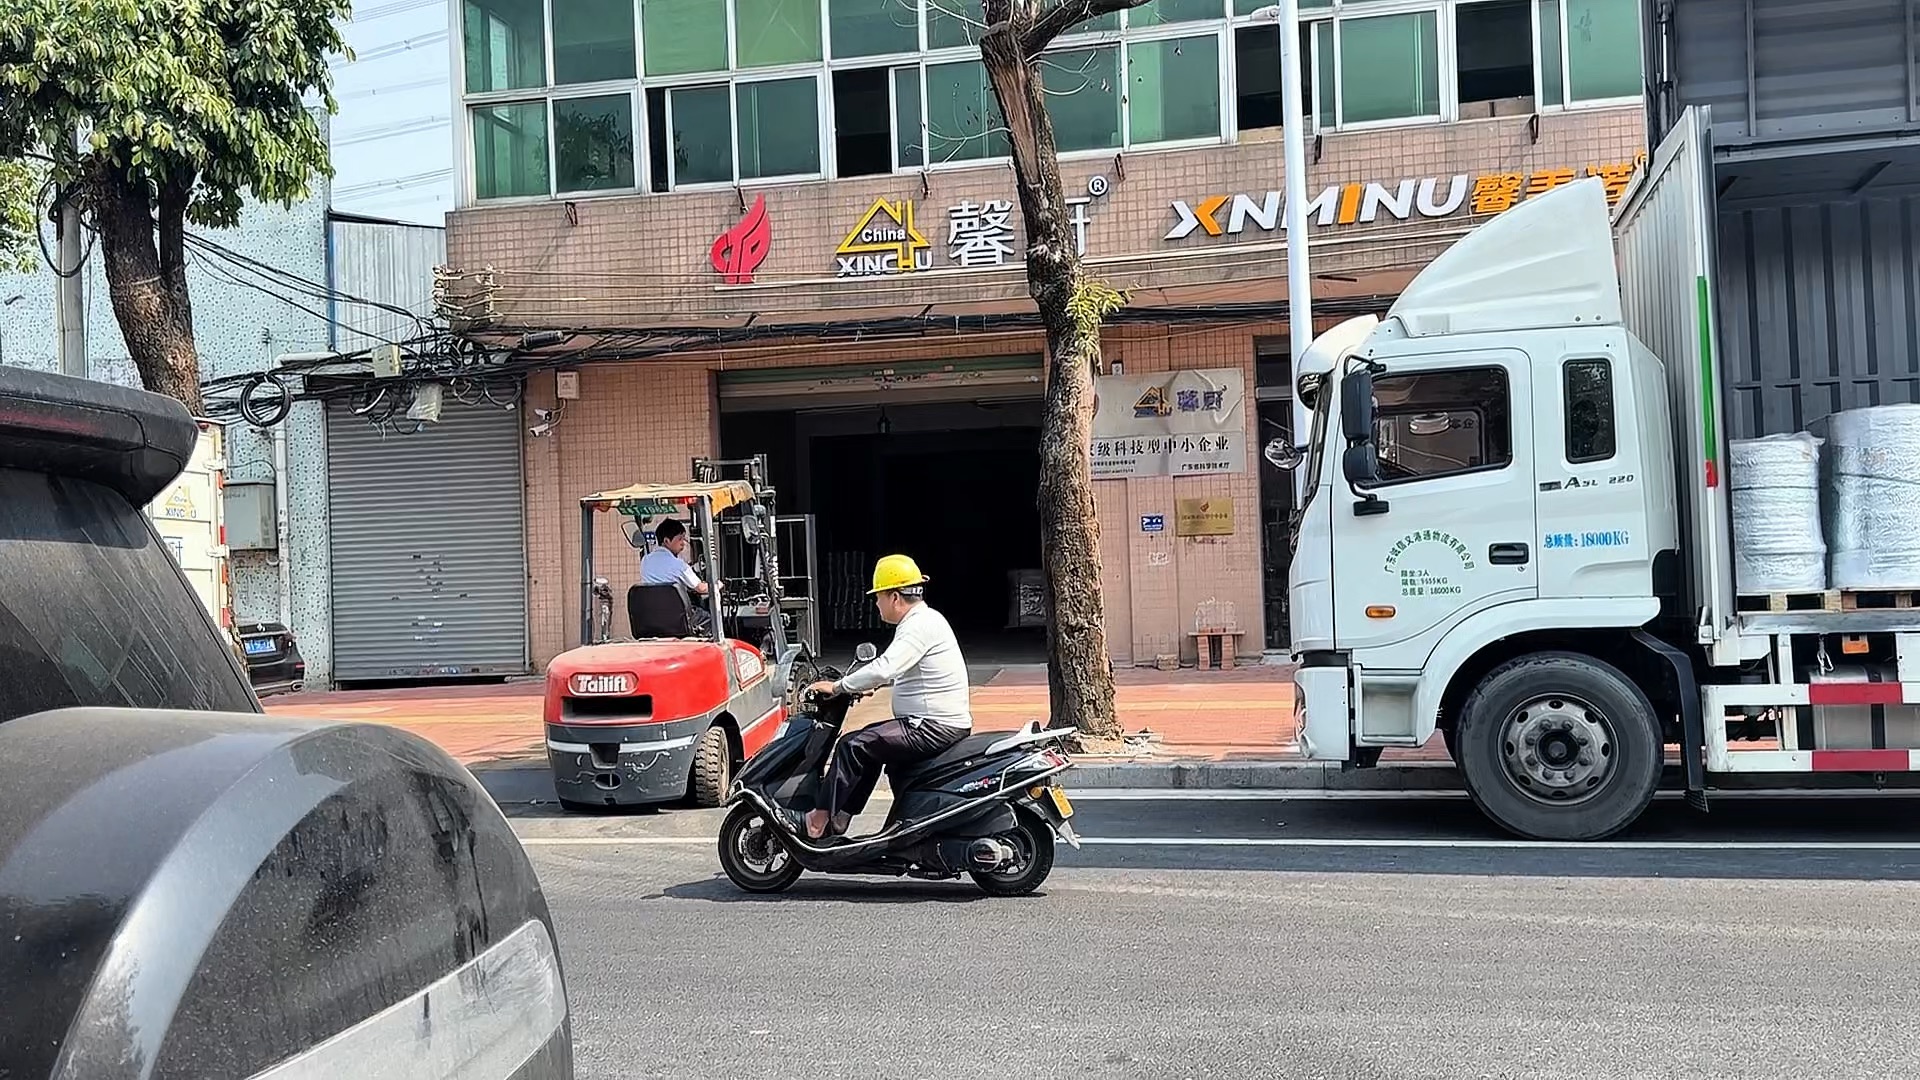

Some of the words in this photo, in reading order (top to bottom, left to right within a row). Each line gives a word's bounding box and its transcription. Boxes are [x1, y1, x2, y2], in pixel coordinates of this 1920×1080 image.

[861, 227, 906, 243] China
[837, 251, 933, 277] XINCHU
[577, 674, 628, 693] Tailift
